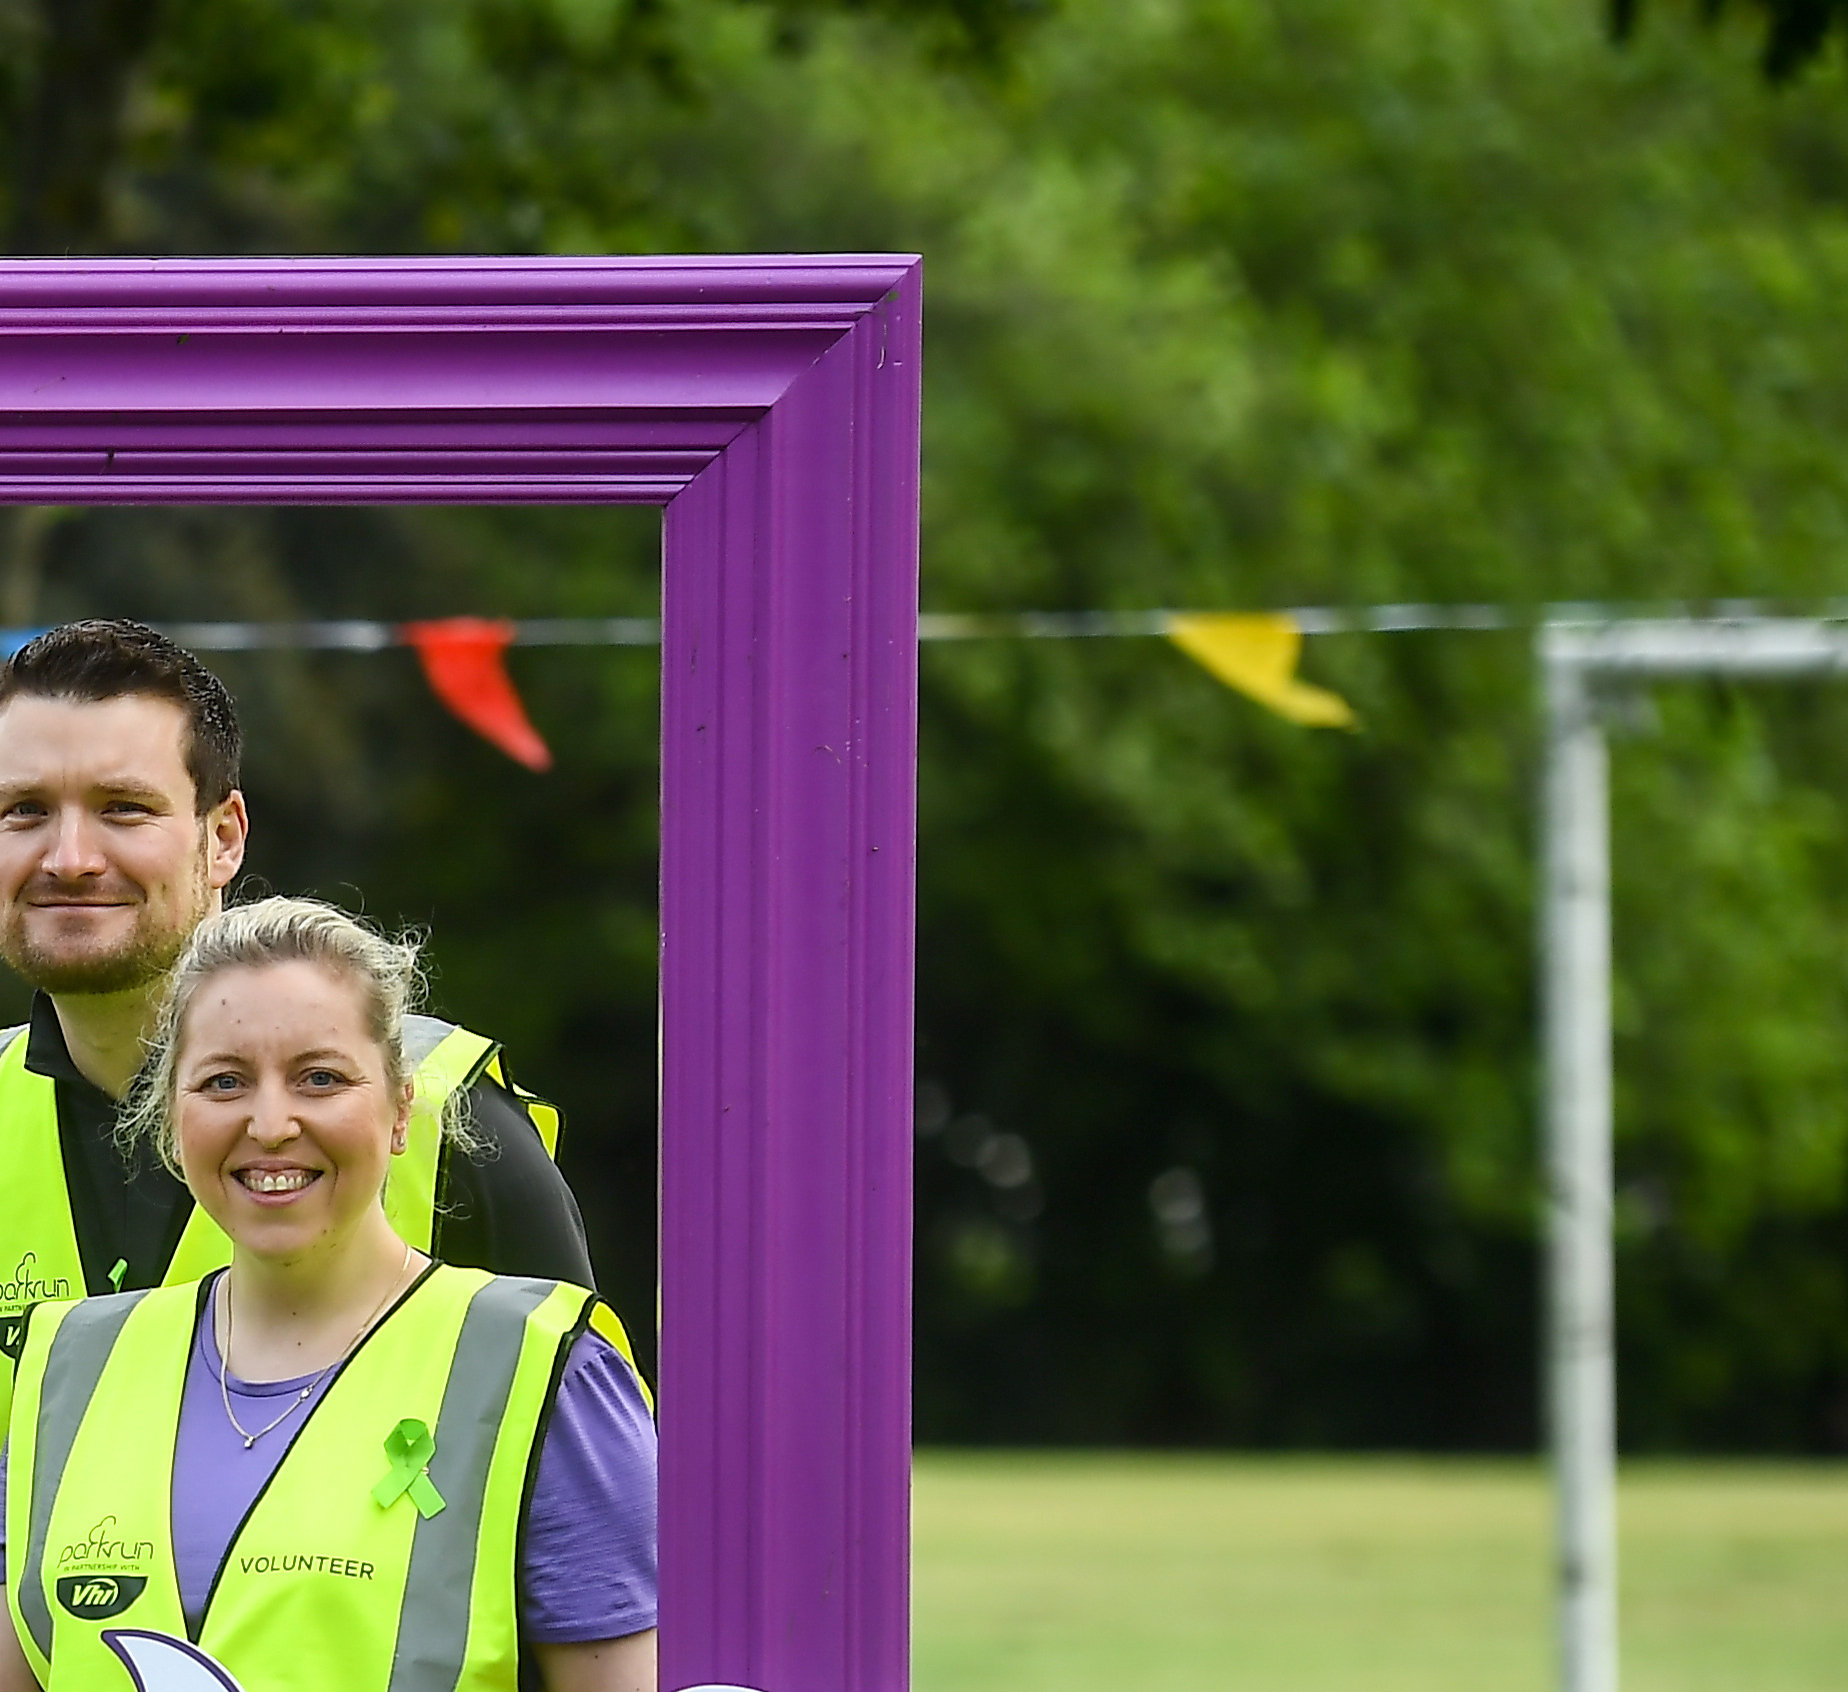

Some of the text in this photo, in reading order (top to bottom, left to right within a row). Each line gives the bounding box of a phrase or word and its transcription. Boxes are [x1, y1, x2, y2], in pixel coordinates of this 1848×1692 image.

[57, 1515, 154, 1568] parkrun
[240, 1555, 375, 1580] VOLUNTEER
[72, 1584, 114, 1606] Vhi
